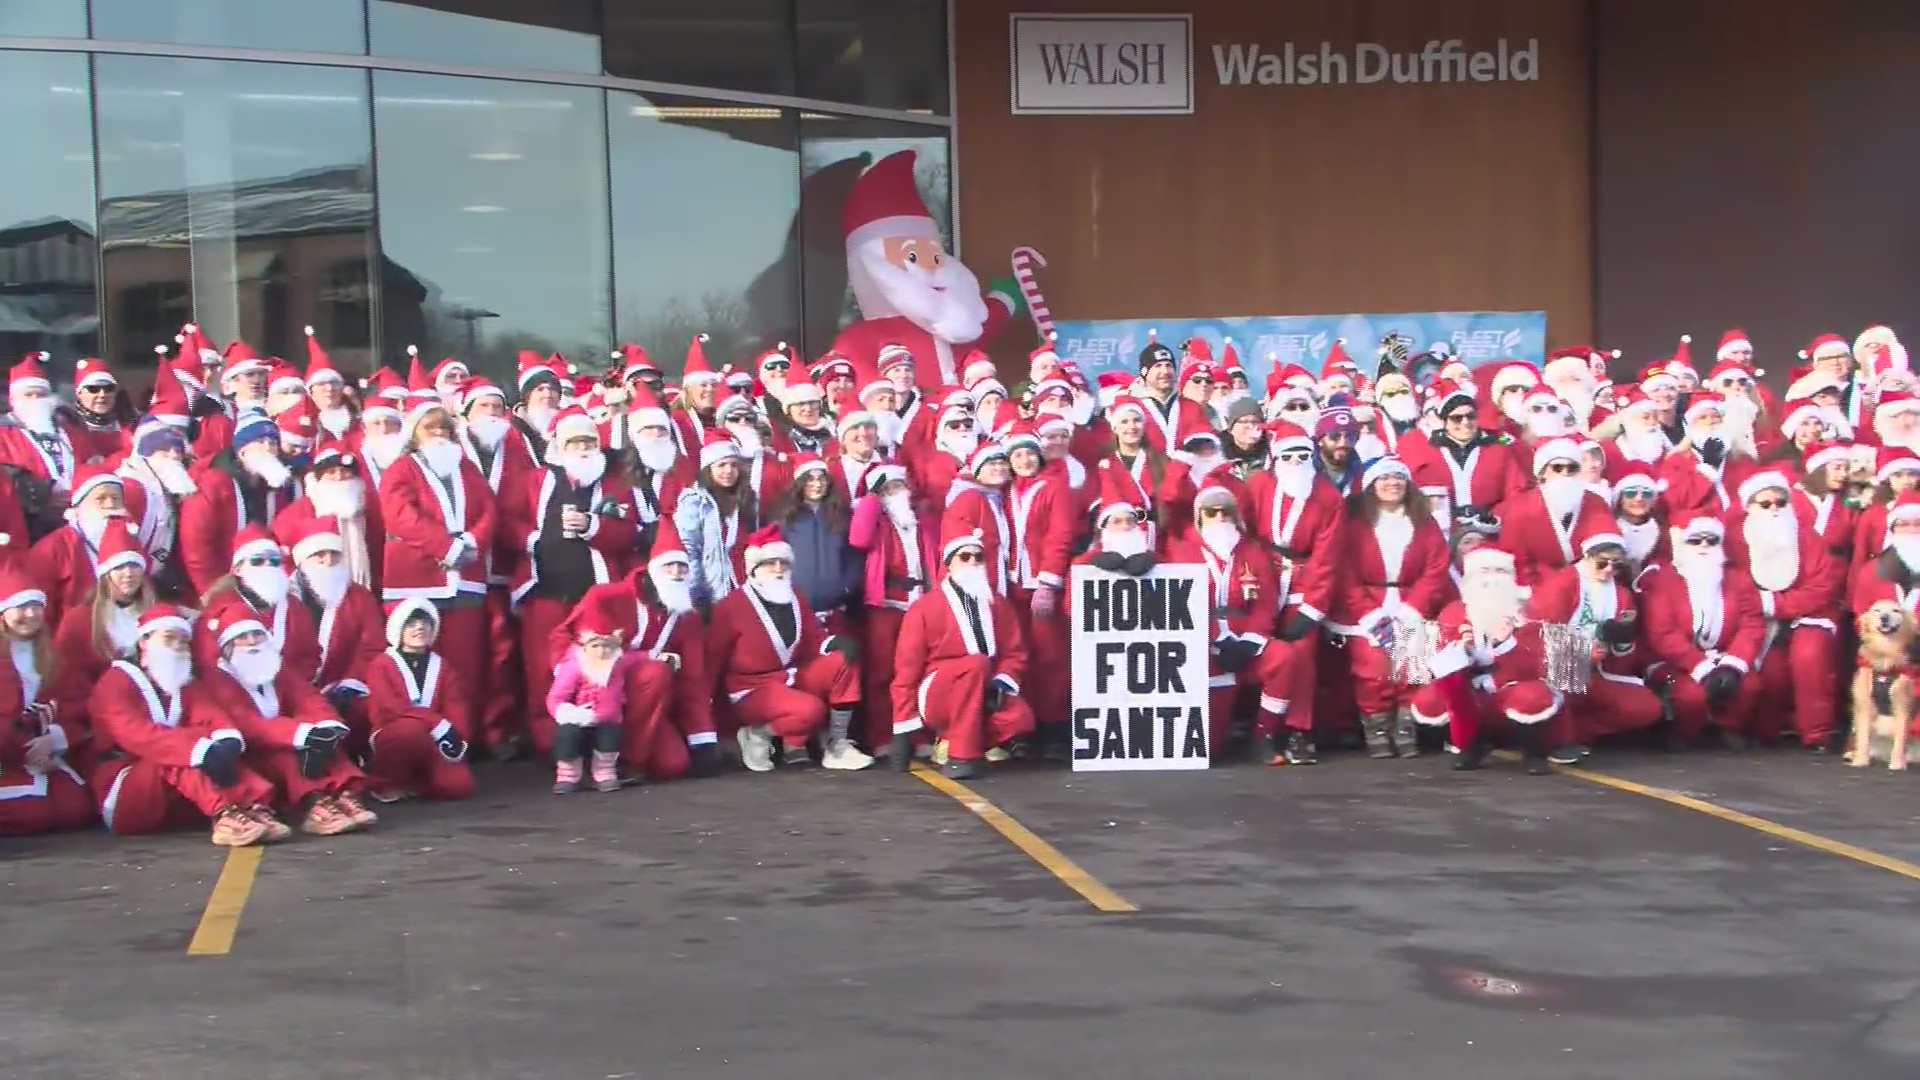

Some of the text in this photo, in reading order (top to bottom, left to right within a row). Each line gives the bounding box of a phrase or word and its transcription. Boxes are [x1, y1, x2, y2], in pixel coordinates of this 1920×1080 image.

[1038, 43, 1165, 85] WALSH
[1067, 338, 1119, 353] FLEET
[1452, 331, 1505, 344] FLEET
[1083, 578, 1194, 632] HONK
[1096, 641, 1187, 694] FOR
[1074, 706, 1207, 760] SANTA
